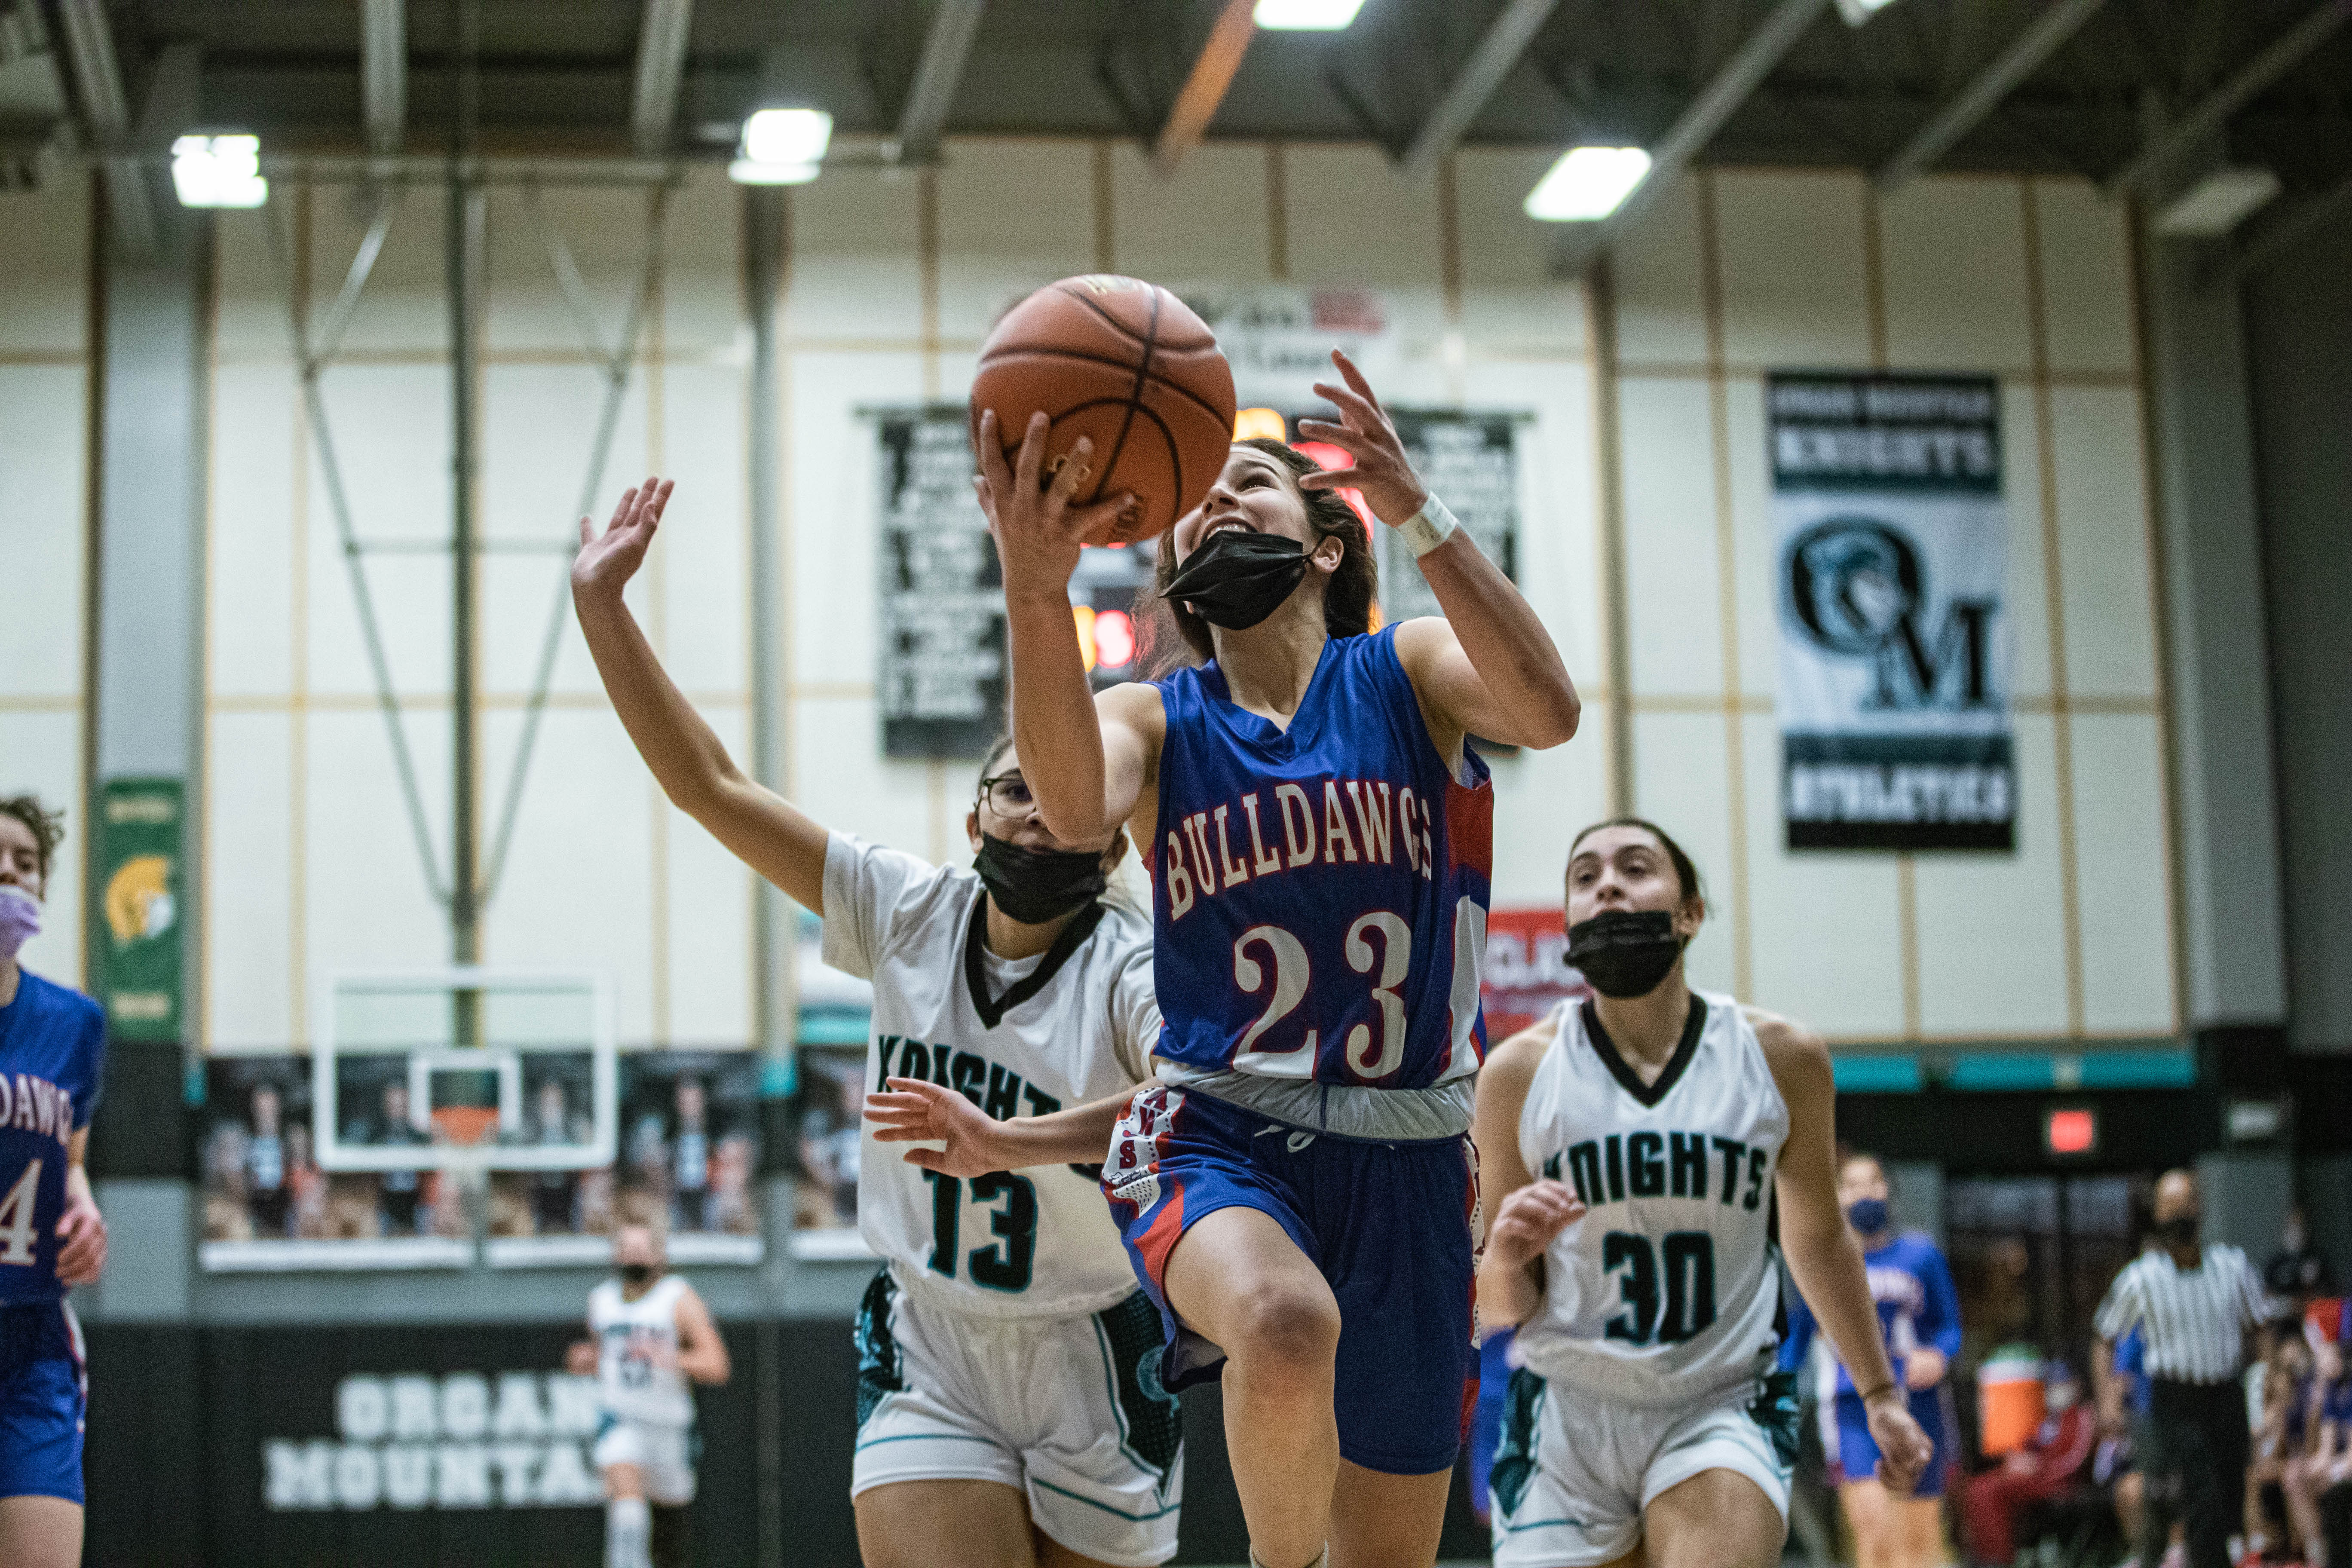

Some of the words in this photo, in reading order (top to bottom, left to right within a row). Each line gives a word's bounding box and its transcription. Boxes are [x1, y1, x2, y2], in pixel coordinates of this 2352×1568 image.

[1167, 781, 1432, 921] BULLDAWGS
[1232, 911, 1412, 1080] 23
[921, 1167, 1038, 1293] 13
[1603, 1231, 1716, 1344] 30
